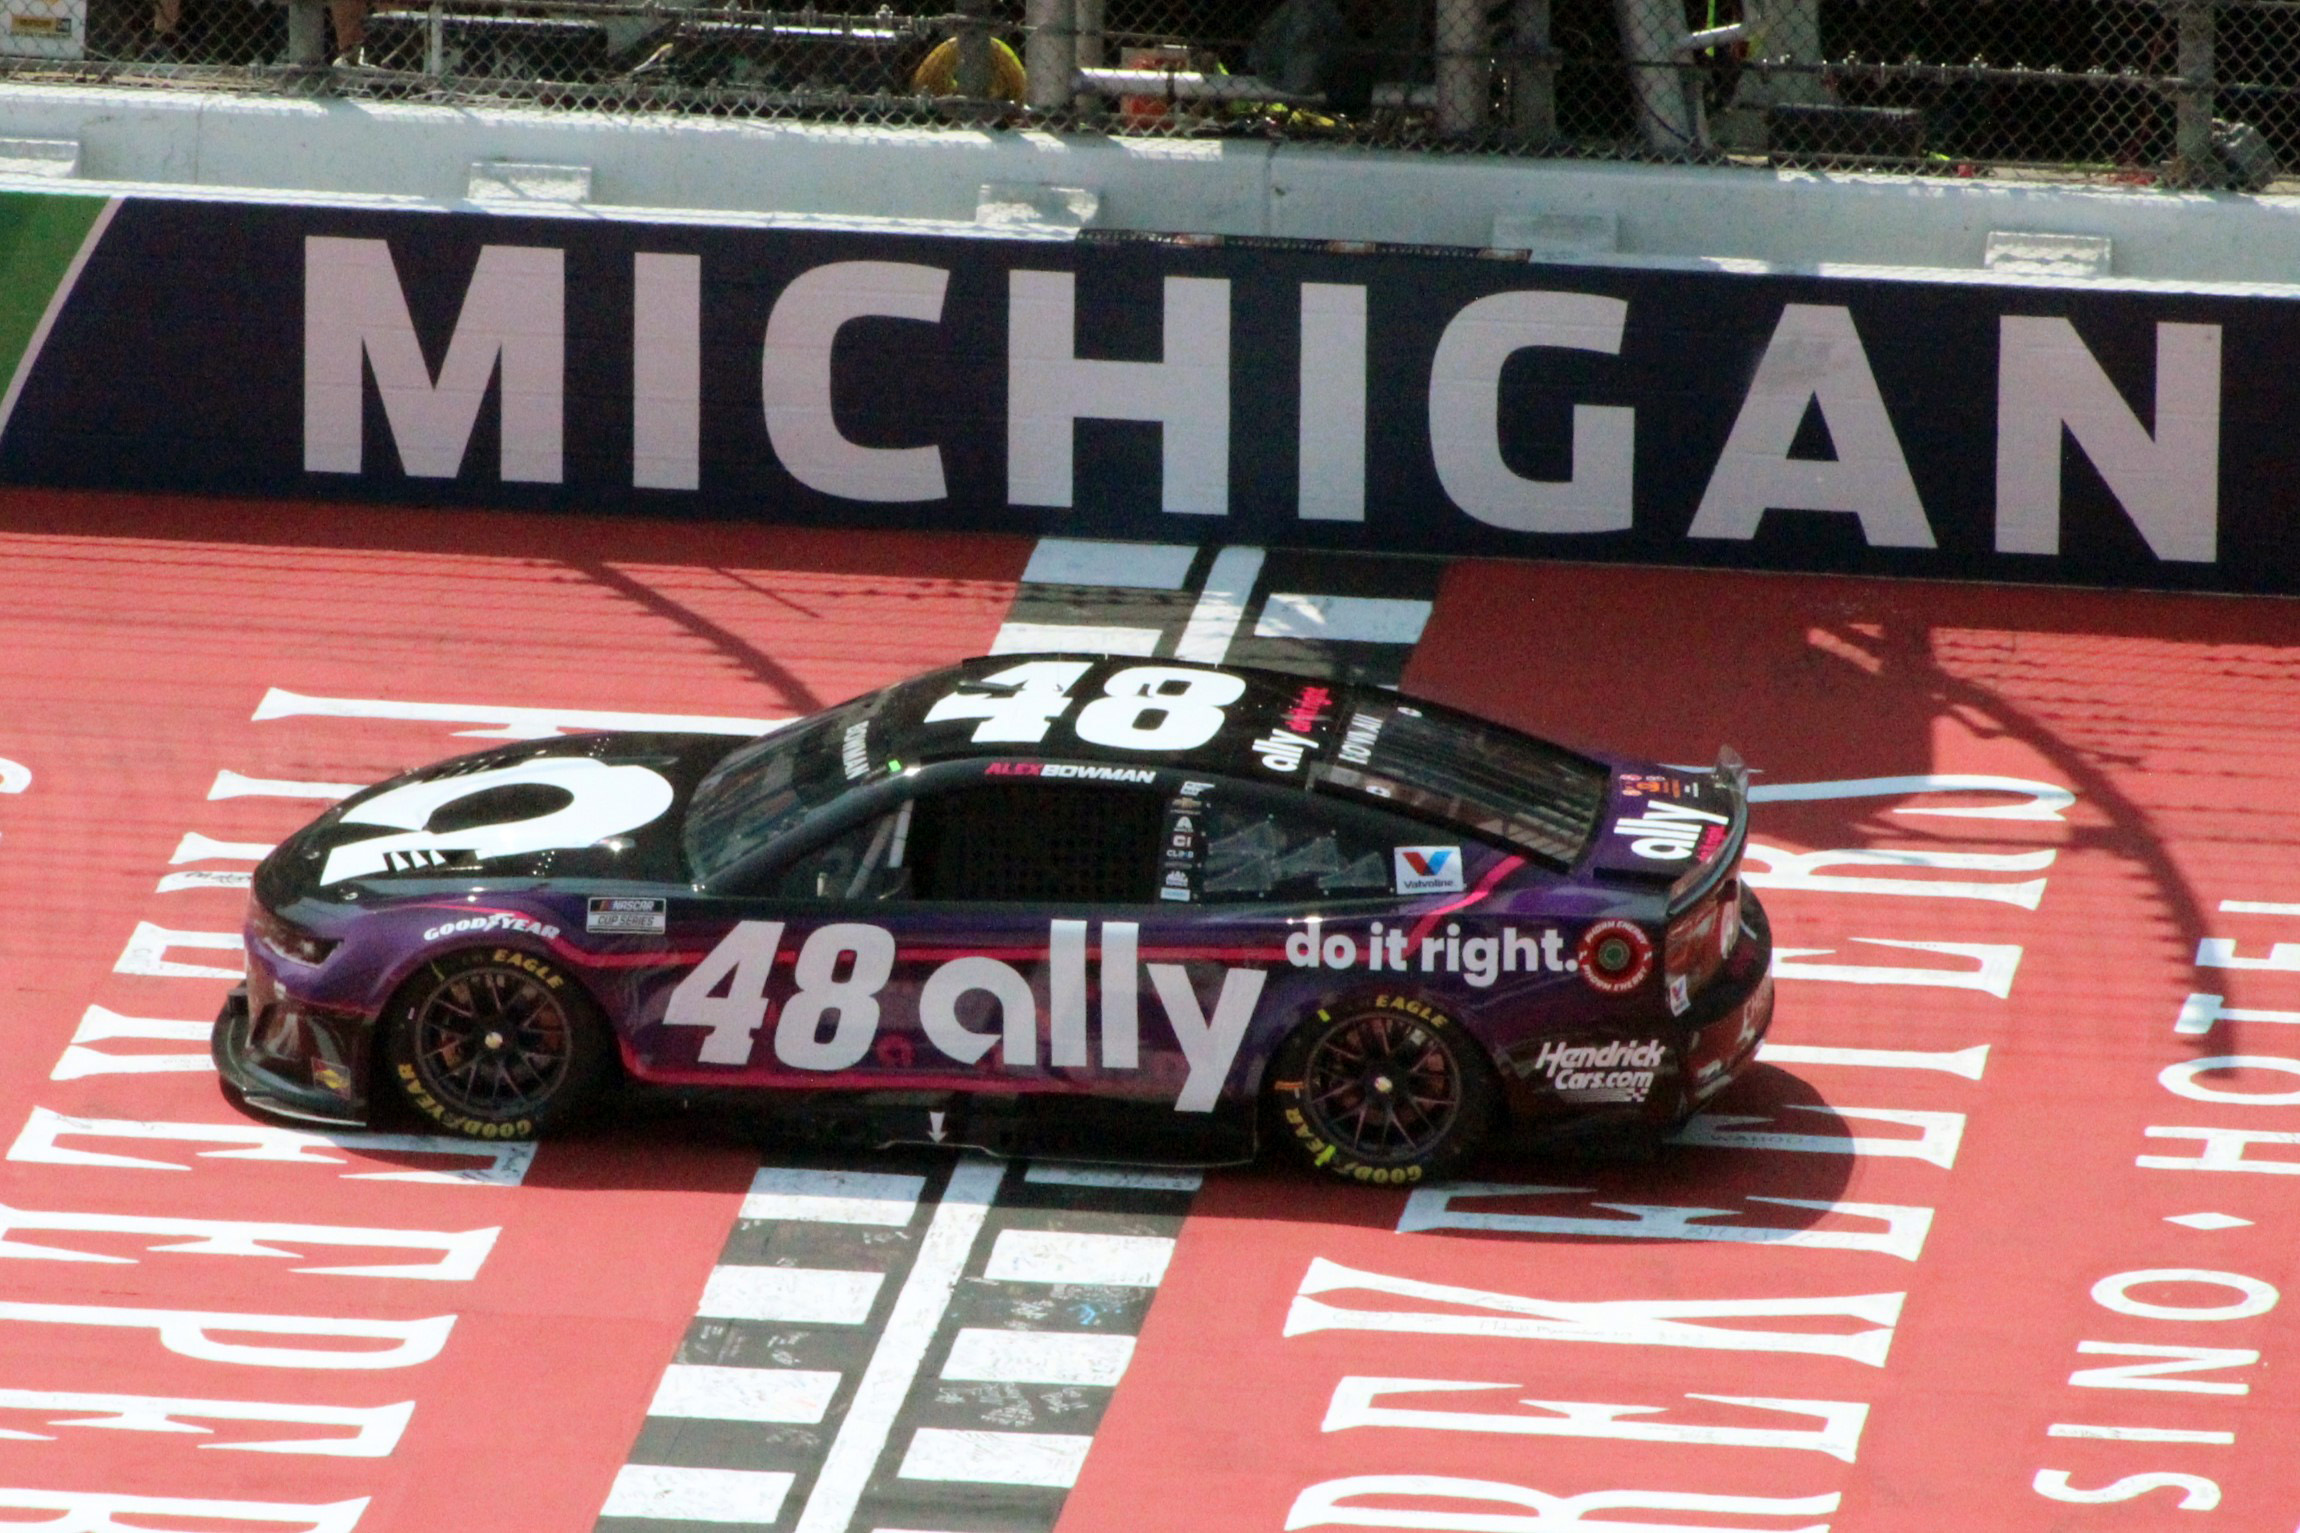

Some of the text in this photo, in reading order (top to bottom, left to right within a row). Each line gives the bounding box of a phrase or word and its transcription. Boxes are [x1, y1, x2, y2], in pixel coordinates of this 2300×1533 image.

[302, 234, 2223, 564] MICHIGAN
[924, 661, 1246, 751] 48
[1252, 728, 1319, 772] ally
[984, 762, 1157, 785] ALEX BOWMAN
[1613, 800, 1730, 860] ally
[1404, 879, 1454, 889] Valvoline
[423, 912, 561, 941] GOODYEAR
[597, 914, 655, 927] CUP SERIES
[612, 900, 654, 911] NASCAR
[492, 948, 565, 989] EAGLE
[1285, 918, 1579, 988] do it right.
[661, 919, 896, 1071] 48
[919, 918, 1268, 1113] ally
[1375, 993, 1448, 1029] EAGLE
[1535, 1039, 1666, 1078] Hendrick
[1554, 1068, 1654, 1090] Cars.com
[1285, 1107, 1423, 1185] GOODEAR
[2032, 1268, 2281, 1512] SINO
